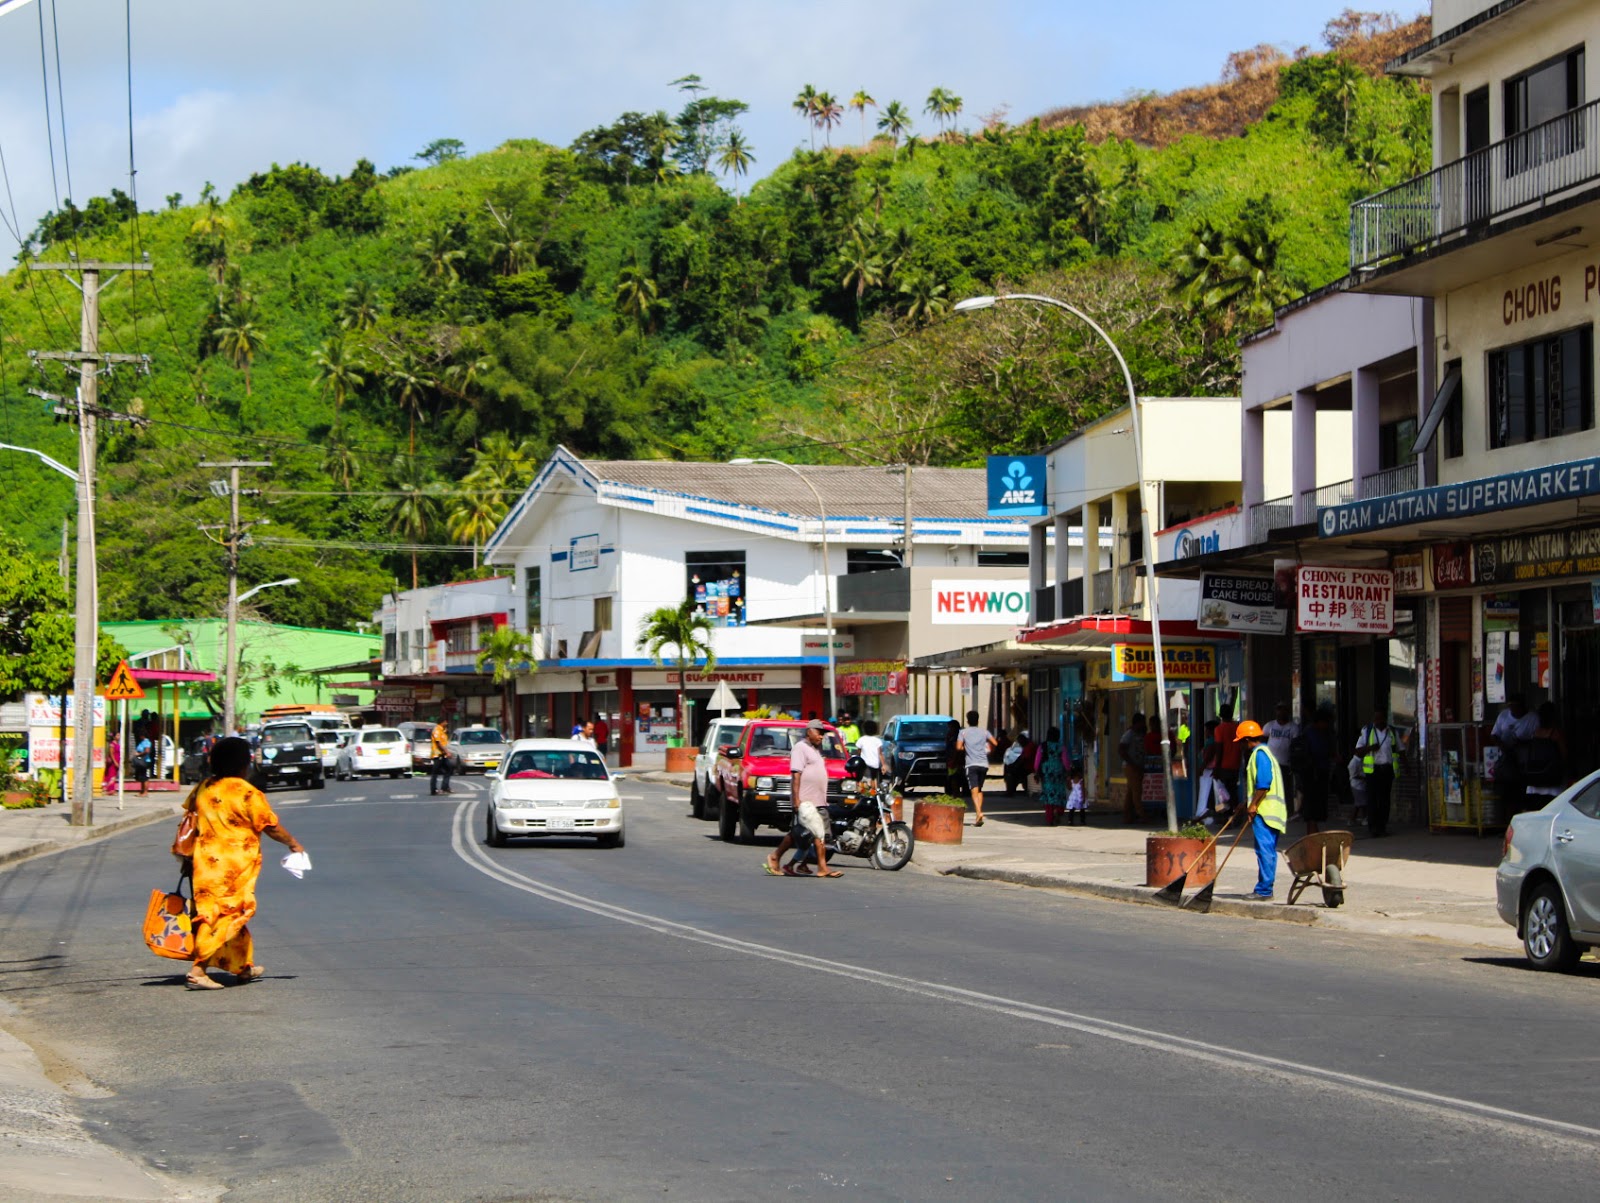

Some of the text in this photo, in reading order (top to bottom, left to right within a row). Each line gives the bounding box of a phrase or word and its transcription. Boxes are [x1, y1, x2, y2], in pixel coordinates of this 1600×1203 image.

[1503, 275, 1561, 326] CHONG
[1000, 490, 1035, 504] ANZ
[1340, 505, 1371, 531] RAM
[1378, 492, 1438, 525] JATTAN
[1446, 464, 1595, 513] SUPERMARKET
[1502, 539, 1523, 563] RAM
[1527, 533, 1565, 561] JATTAN
[1209, 578, 1233, 588] LEES
[1235, 580, 1269, 591] BREAD
[1302, 570, 1346, 584] CHONG
[1351, 572, 1390, 586] PONG
[1211, 589, 1273, 602] CAKE HOUSE
[1302, 584, 1391, 602] RESTAURANT
[1121, 648, 1211, 662] Sutek
[686, 673, 765, 682] SUPERMARKET
